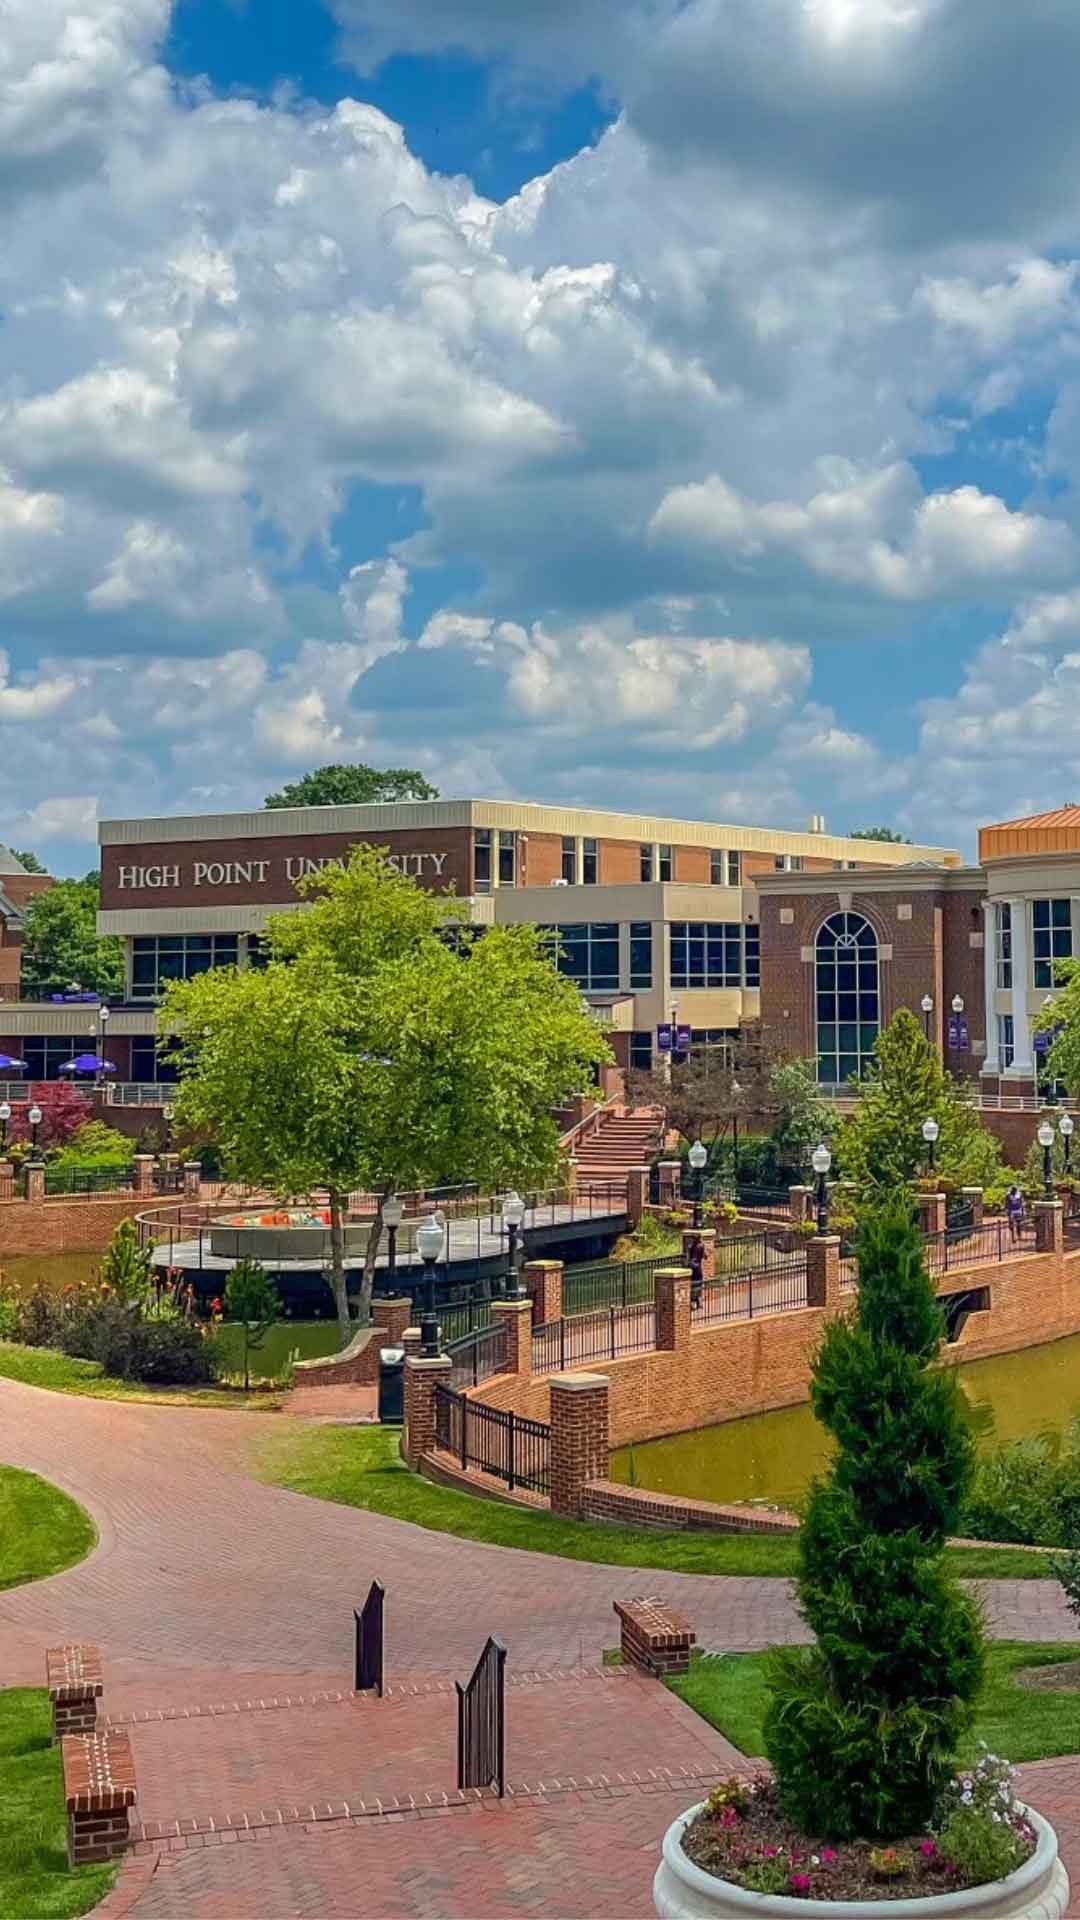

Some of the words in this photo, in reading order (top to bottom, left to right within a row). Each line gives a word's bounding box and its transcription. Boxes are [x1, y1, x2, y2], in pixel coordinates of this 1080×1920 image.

[118, 865, 181, 889] HIGH
[192, 860, 271, 886] POINT
[284, 853, 448, 881] UNVSITY
